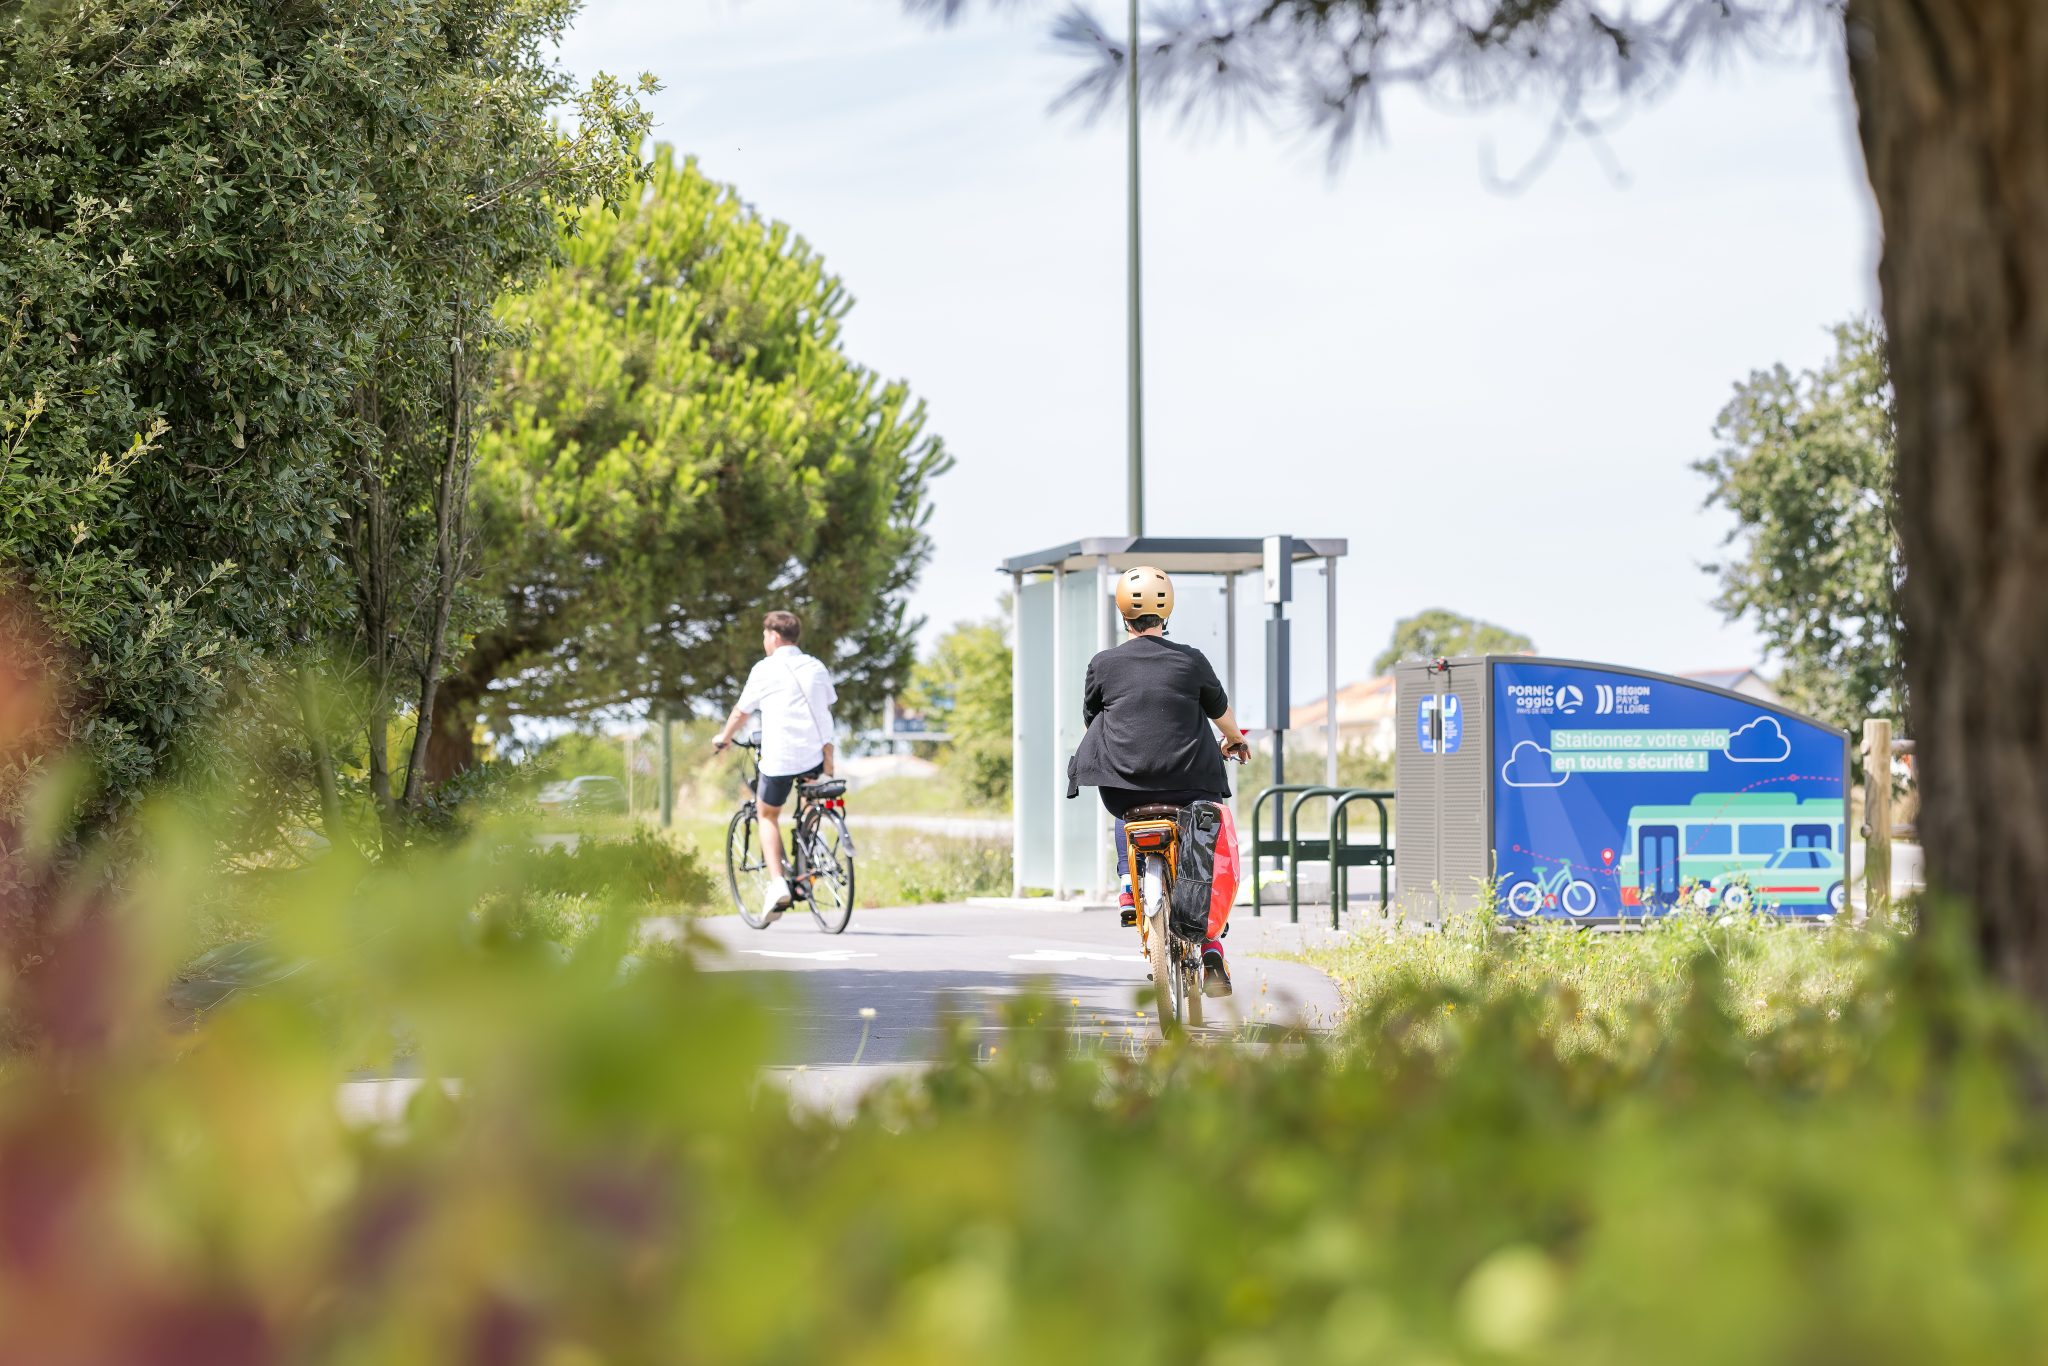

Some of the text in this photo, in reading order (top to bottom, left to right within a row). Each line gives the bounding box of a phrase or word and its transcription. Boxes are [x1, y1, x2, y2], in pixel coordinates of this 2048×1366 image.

[1615, 685, 1650, 697] RÉGION
[1517, 696, 1554, 709] agglo
[1615, 697, 1639, 706] PAYS
[1624, 704, 1650, 714] LOIRE
[1554, 731, 1726, 748] Stationnez votre vélo
[1554, 757, 1576, 769] en
[1580, 755, 1623, 769] toute
[1627, 752, 1696, 769] sécurité
